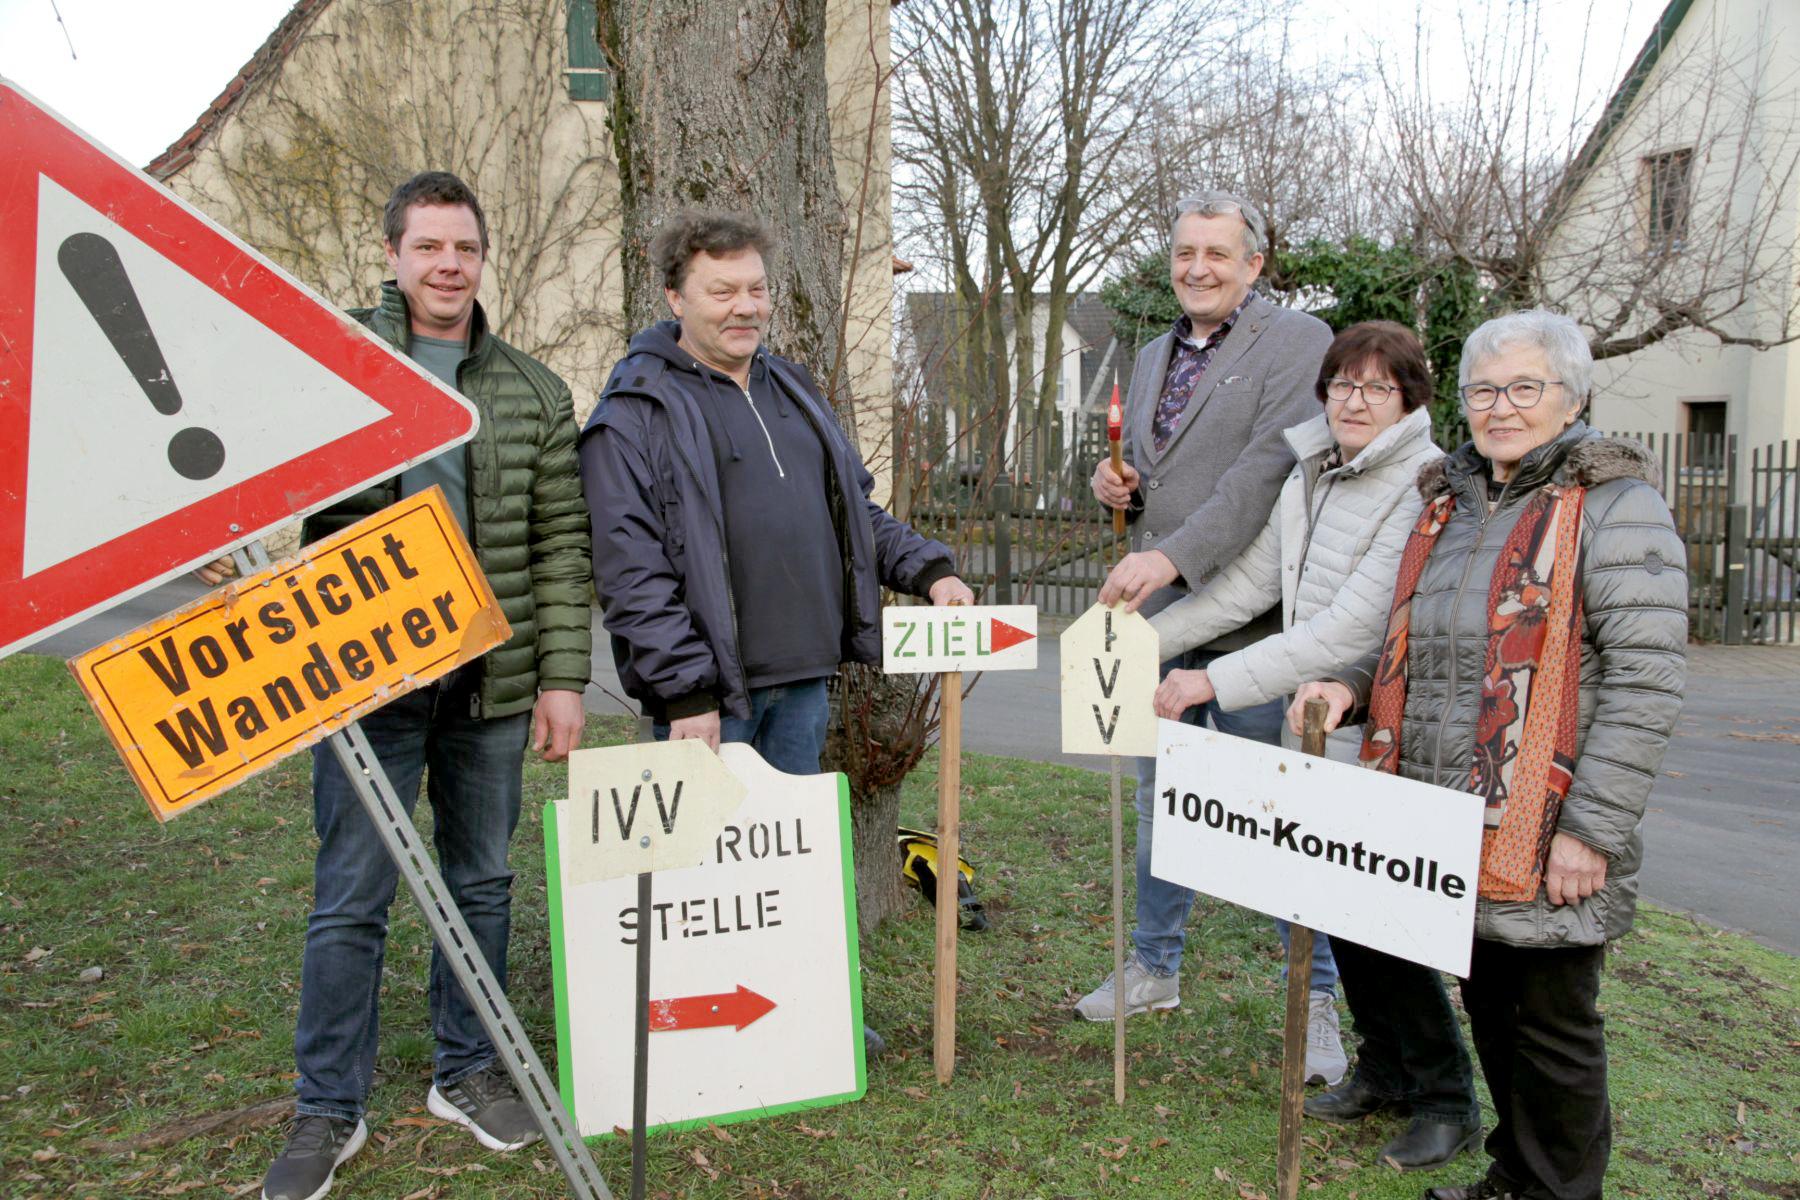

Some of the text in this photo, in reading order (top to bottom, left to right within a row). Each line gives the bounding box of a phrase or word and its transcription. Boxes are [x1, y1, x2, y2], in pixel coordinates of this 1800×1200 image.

[139, 533, 418, 697] Vorsicht
[893, 621, 990, 658] ZIEL
[155, 591, 458, 769] Wanderer
[592, 780, 683, 844] IVV
[716, 818, 812, 864] ROLL
[1162, 787, 1467, 900] 100m-Kontrolle
[618, 889, 782, 945] STELLE
